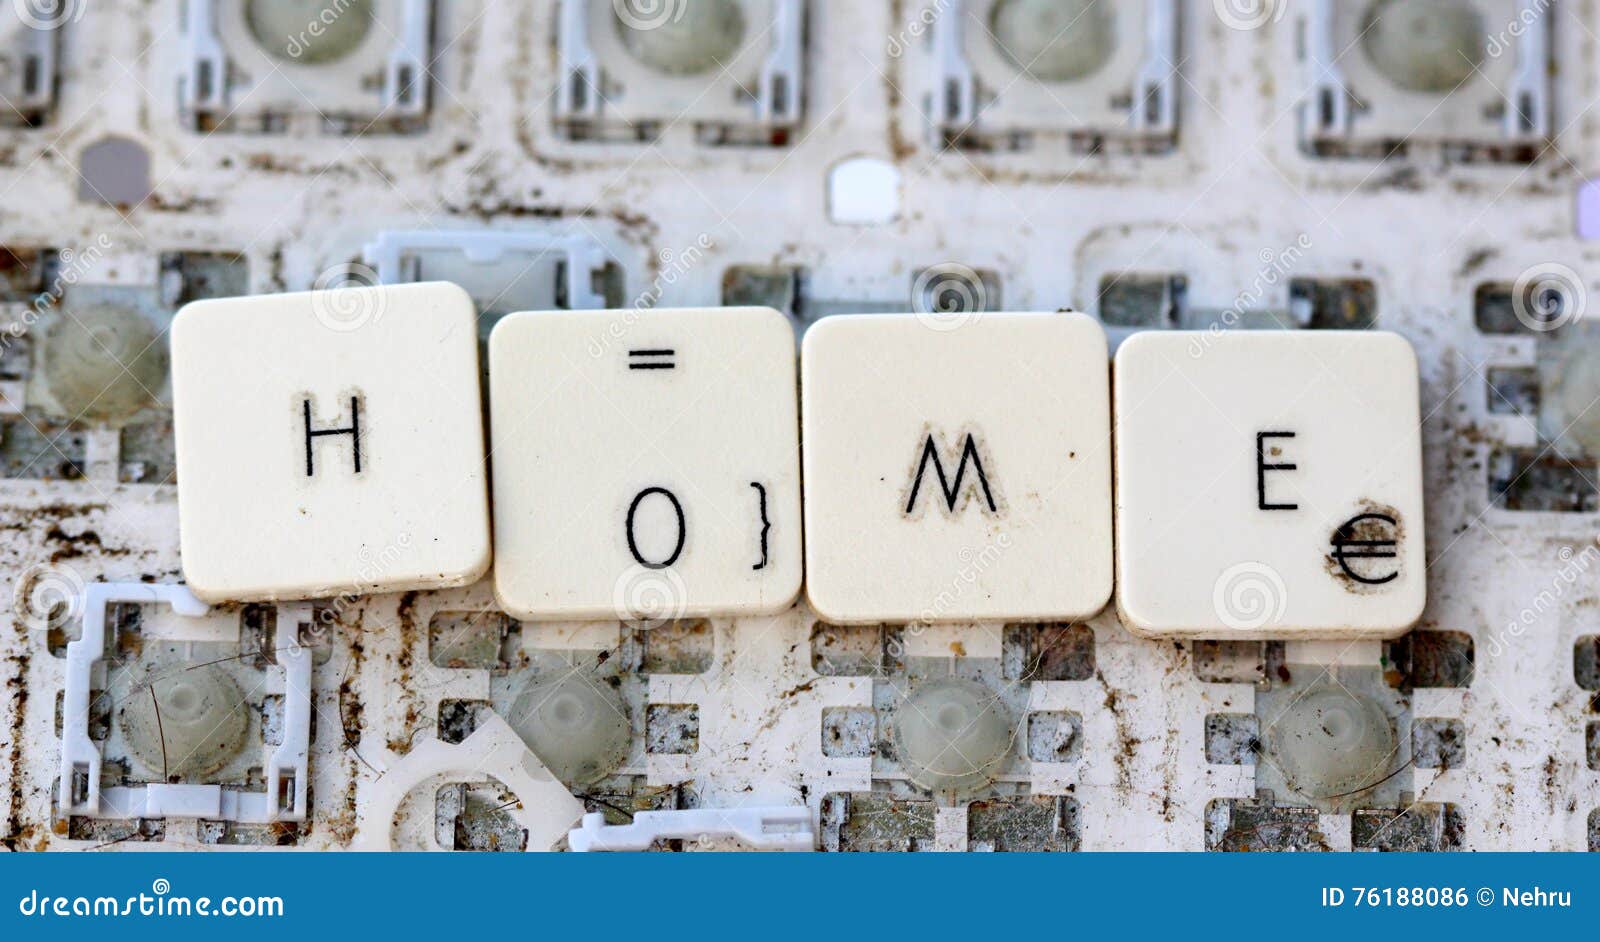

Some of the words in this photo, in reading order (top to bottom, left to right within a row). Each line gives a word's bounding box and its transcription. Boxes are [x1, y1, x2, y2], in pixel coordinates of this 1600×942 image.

[629, 349, 675, 369] =
[304, 397, 361, 477] H
[906, 432, 997, 514] M
[1256, 431, 1298, 511] E
[1331, 513, 1399, 584] €
